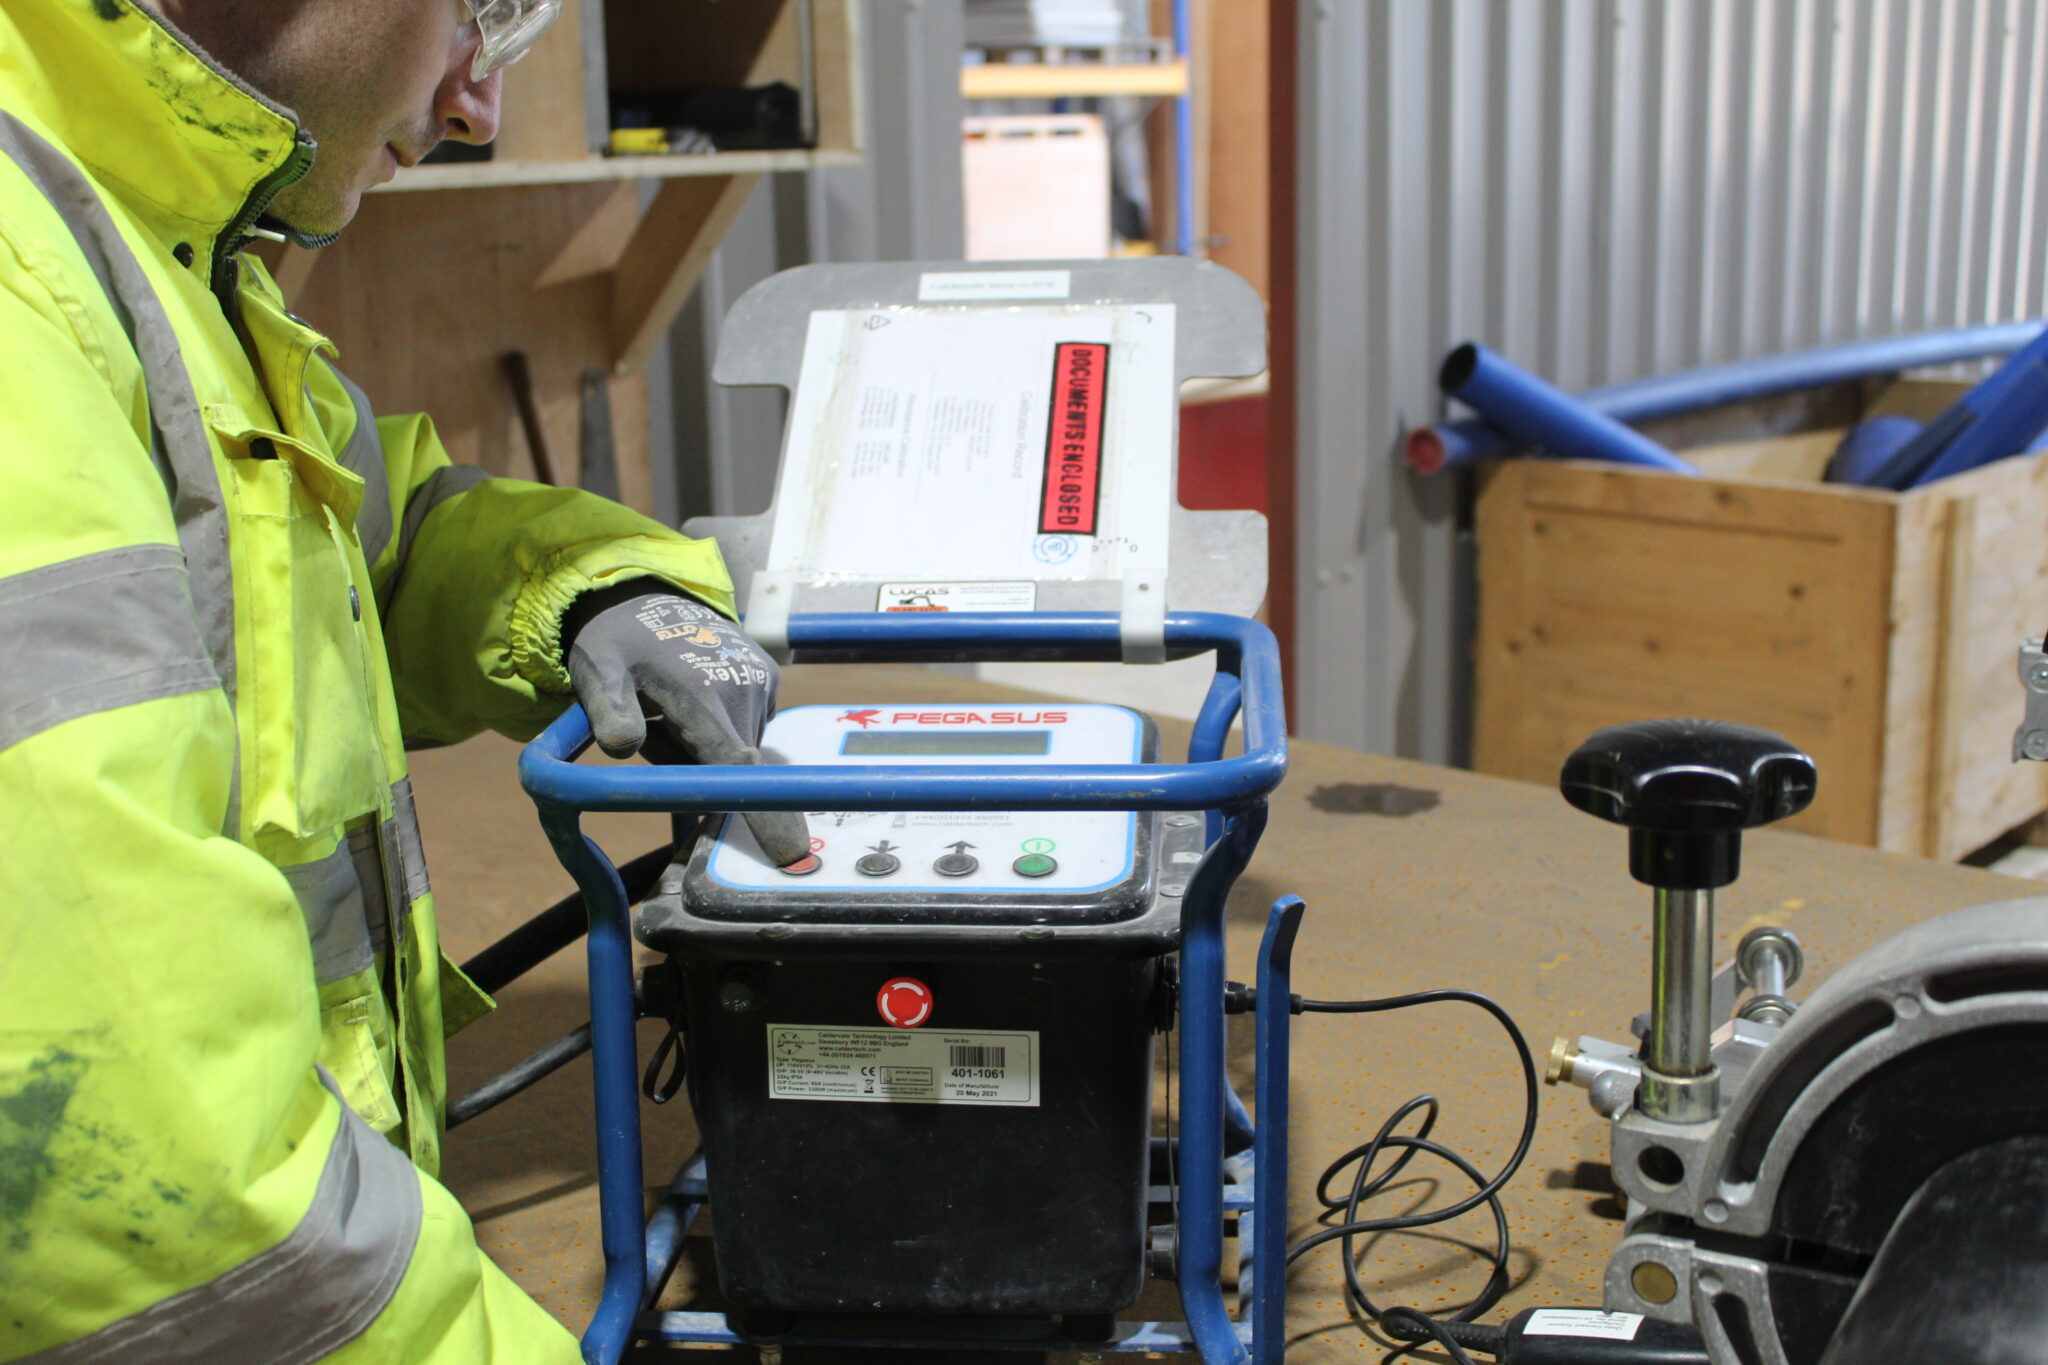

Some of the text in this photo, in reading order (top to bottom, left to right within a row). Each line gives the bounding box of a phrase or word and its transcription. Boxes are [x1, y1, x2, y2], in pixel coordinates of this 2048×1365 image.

[1057, 349, 1093, 525] DOCUMENTS ENCLOSED
[889, 586, 950, 596] LUCAS
[892, 712, 1068, 725] PEGASUS
[861, 1067, 876, 1076] CE
[951, 1068, 1005, 1079] 401-1061
